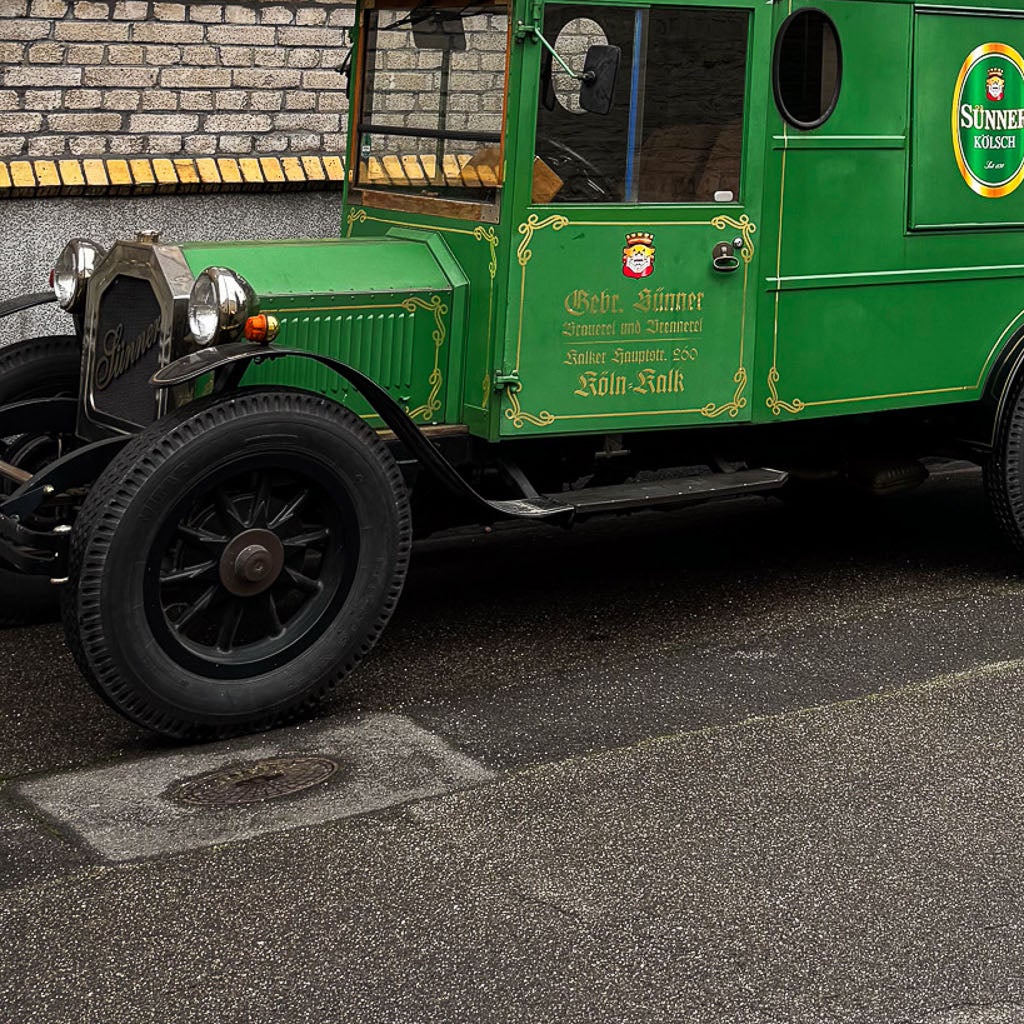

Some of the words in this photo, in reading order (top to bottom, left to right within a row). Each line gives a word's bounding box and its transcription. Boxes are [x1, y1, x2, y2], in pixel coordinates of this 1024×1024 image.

[973, 132, 1016, 150] KÖLSCH
[564, 288, 624, 317] Gebr.
[633, 286, 705, 312] Sünner
[562, 320, 616, 337] Brauerei
[621, 320, 641, 335] und
[645, 317, 703, 334] Brennerei
[563, 349, 606, 365] Kalker
